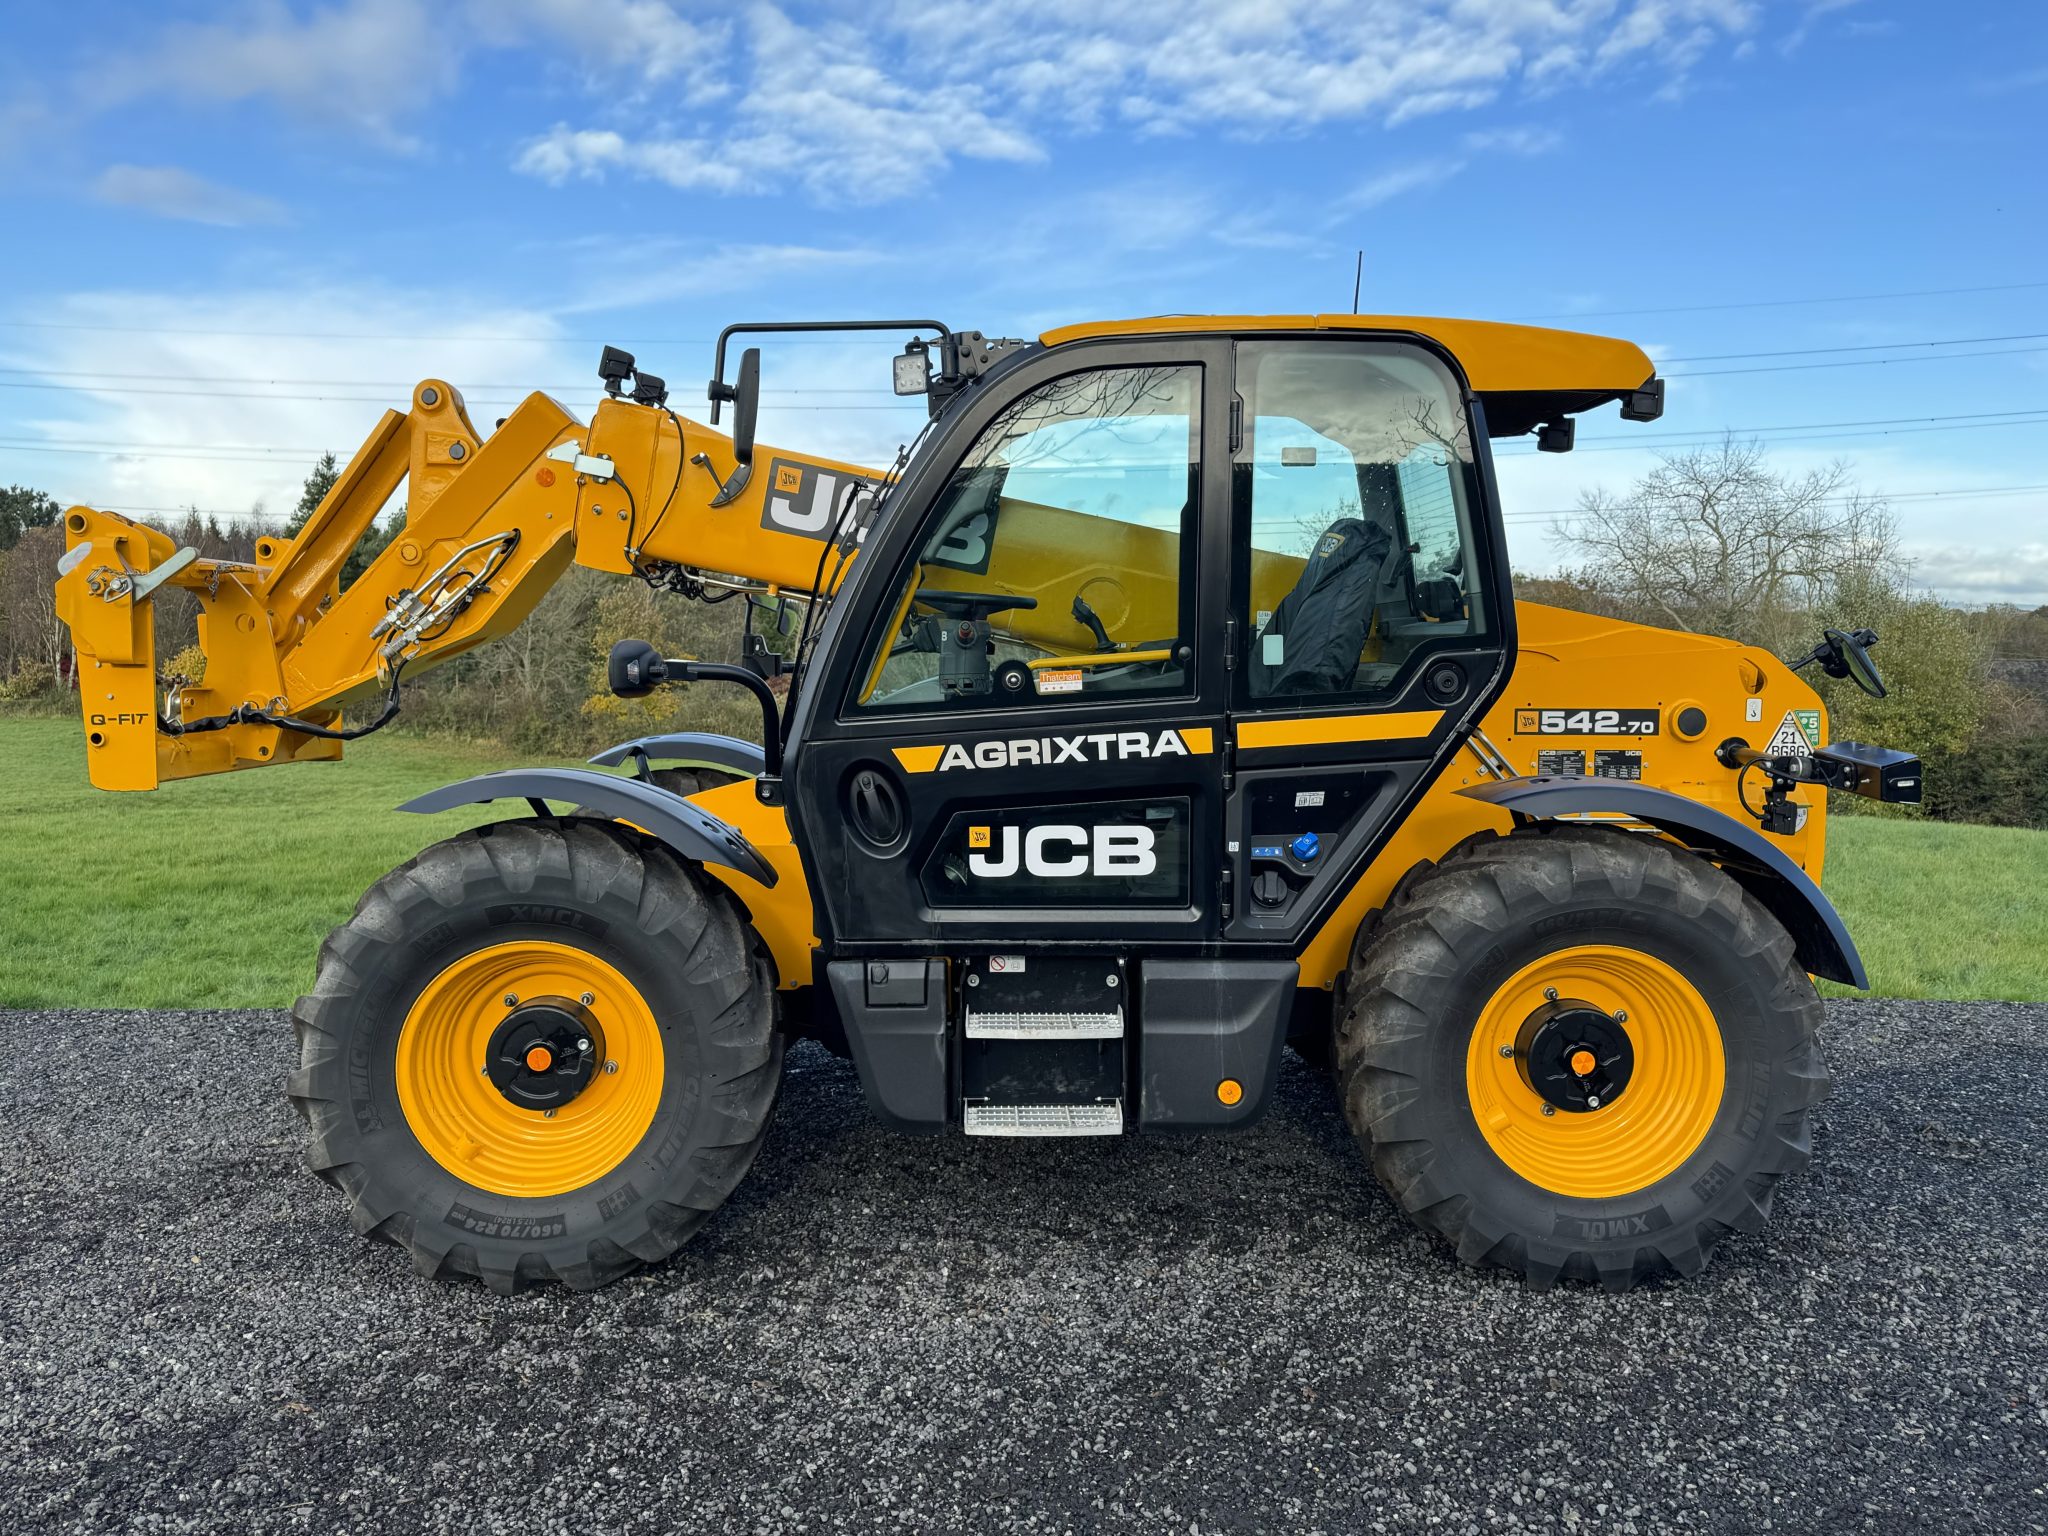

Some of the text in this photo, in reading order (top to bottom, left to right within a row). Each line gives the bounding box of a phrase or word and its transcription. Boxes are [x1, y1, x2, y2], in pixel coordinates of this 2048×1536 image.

[1040, 672, 1082, 682] Thatcham
[90, 713, 149, 726] Q-FIT
[1540, 710, 1654, 734] 542-70
[1808, 717, 1818, 729] 5
[1781, 731, 1797, 744] 21
[938, 729, 1188, 772] AGRIXTRA
[968, 825, 1157, 877] JCB
